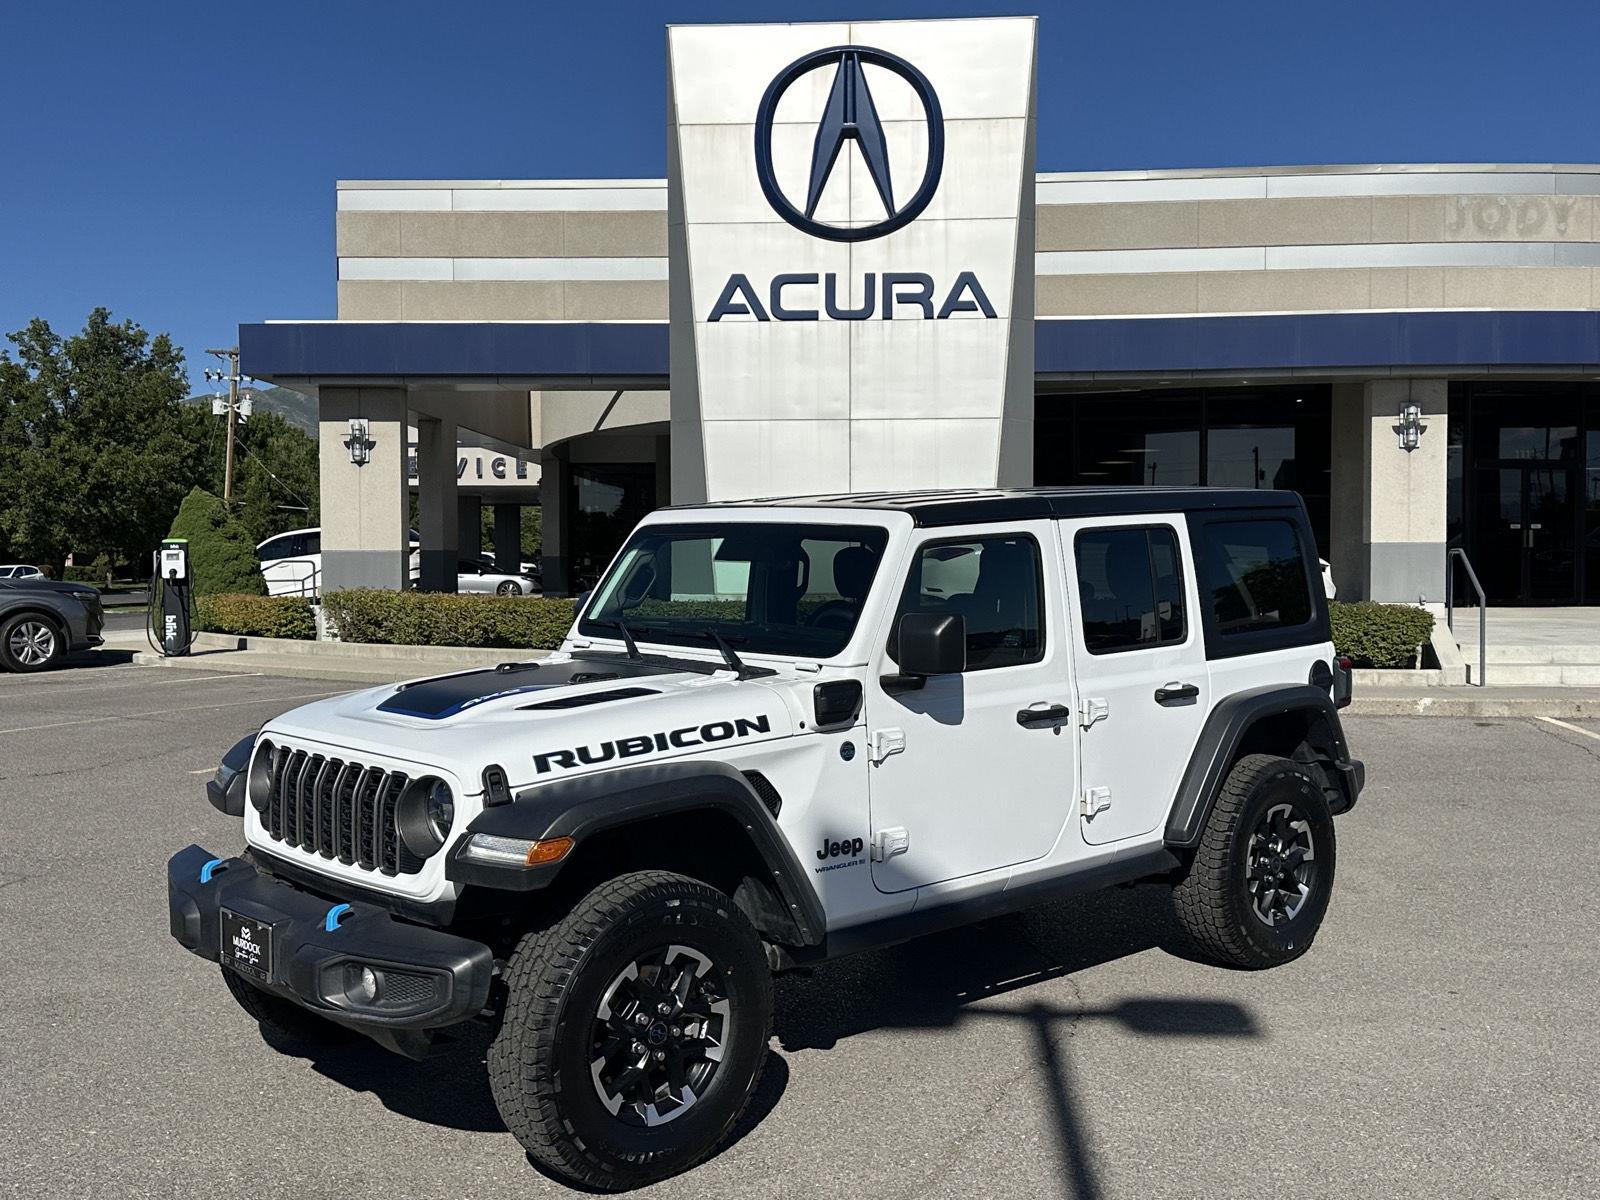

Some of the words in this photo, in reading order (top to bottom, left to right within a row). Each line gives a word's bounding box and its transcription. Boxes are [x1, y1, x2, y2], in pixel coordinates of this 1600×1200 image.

[707, 271, 998, 322] ACURA
[532, 714, 771, 774] RUBICON
[816, 837, 864, 860] Jeep
[815, 860, 858, 873] WRANGLER
[232, 935, 261, 956] MURDOCK
